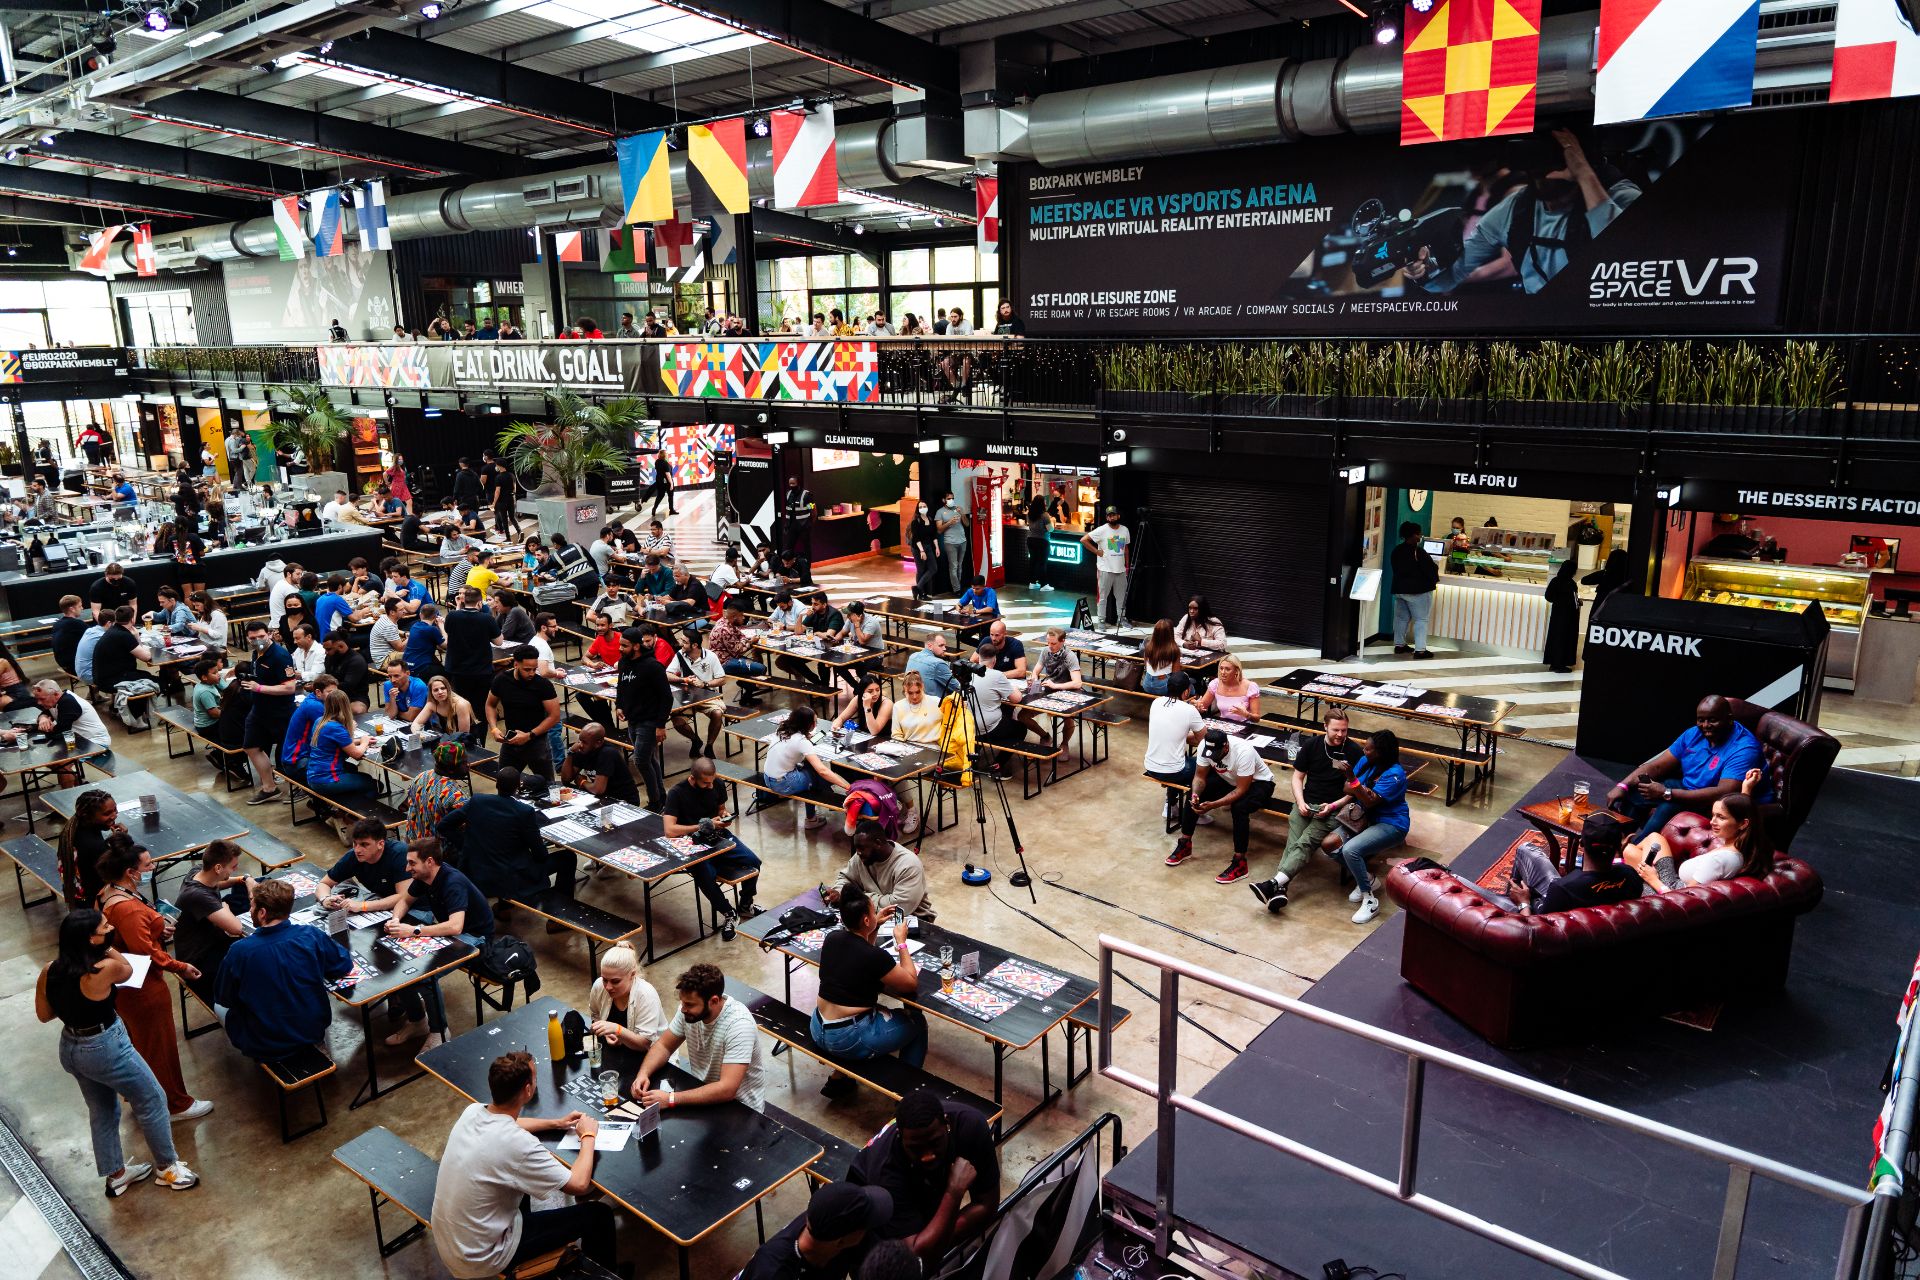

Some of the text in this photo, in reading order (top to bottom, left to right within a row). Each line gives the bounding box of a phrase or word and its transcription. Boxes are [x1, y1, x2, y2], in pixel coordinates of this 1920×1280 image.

[1029, 167, 1144, 191] BOXPARK WEMBLEY
[1030, 182, 1317, 225] MEETSPACE VR VSPORTS ARENA
[1029, 206, 1334, 241] MULTIPLAYER VIRTUAL REALITY ENTERTAINMENT
[1590, 260, 1674, 280] MEET
[1676, 257, 1759, 296] VR
[495, 281, 525, 294] WHER
[1589, 280, 1672, 299] SPACE
[1030, 289, 1177, 307] 1ST FLOOR LEISURE ZONE
[1029, 310, 1048, 319] FREE
[1051, 309, 1071, 318] ROAM
[1074, 309, 1084, 318] VR
[1095, 309, 1106, 317] VR
[1109, 308, 1140, 318] ESCAPE
[1142, 307, 1170, 317] ROOMS
[1183, 307, 1195, 316] VR
[1198, 306, 1233, 316] ARCADE
[1246, 304, 1288, 315] COMPANY
[1292, 303, 1335, 314] SOCIALS
[1350, 301, 1459, 313] MEETSPACEVR.CO.UK
[22, 352, 78, 361] #EURO2020
[23, 359, 119, 370] @BOXPARKWEMBLEY
[452, 349, 624, 382] EAT. DRINK. GOAL!
[825, 434, 875, 446] CLEAN KITCHEN
[986, 444, 1039, 457] NANNY BILL'S
[1453, 472, 1517, 488] TEA FOR U
[1737, 490, 1769, 505] THE
[1771, 492, 1859, 511] DESSERTS
[1588, 624, 1704, 658] BOXPARK
[735, 1178, 751, 1189] 50
